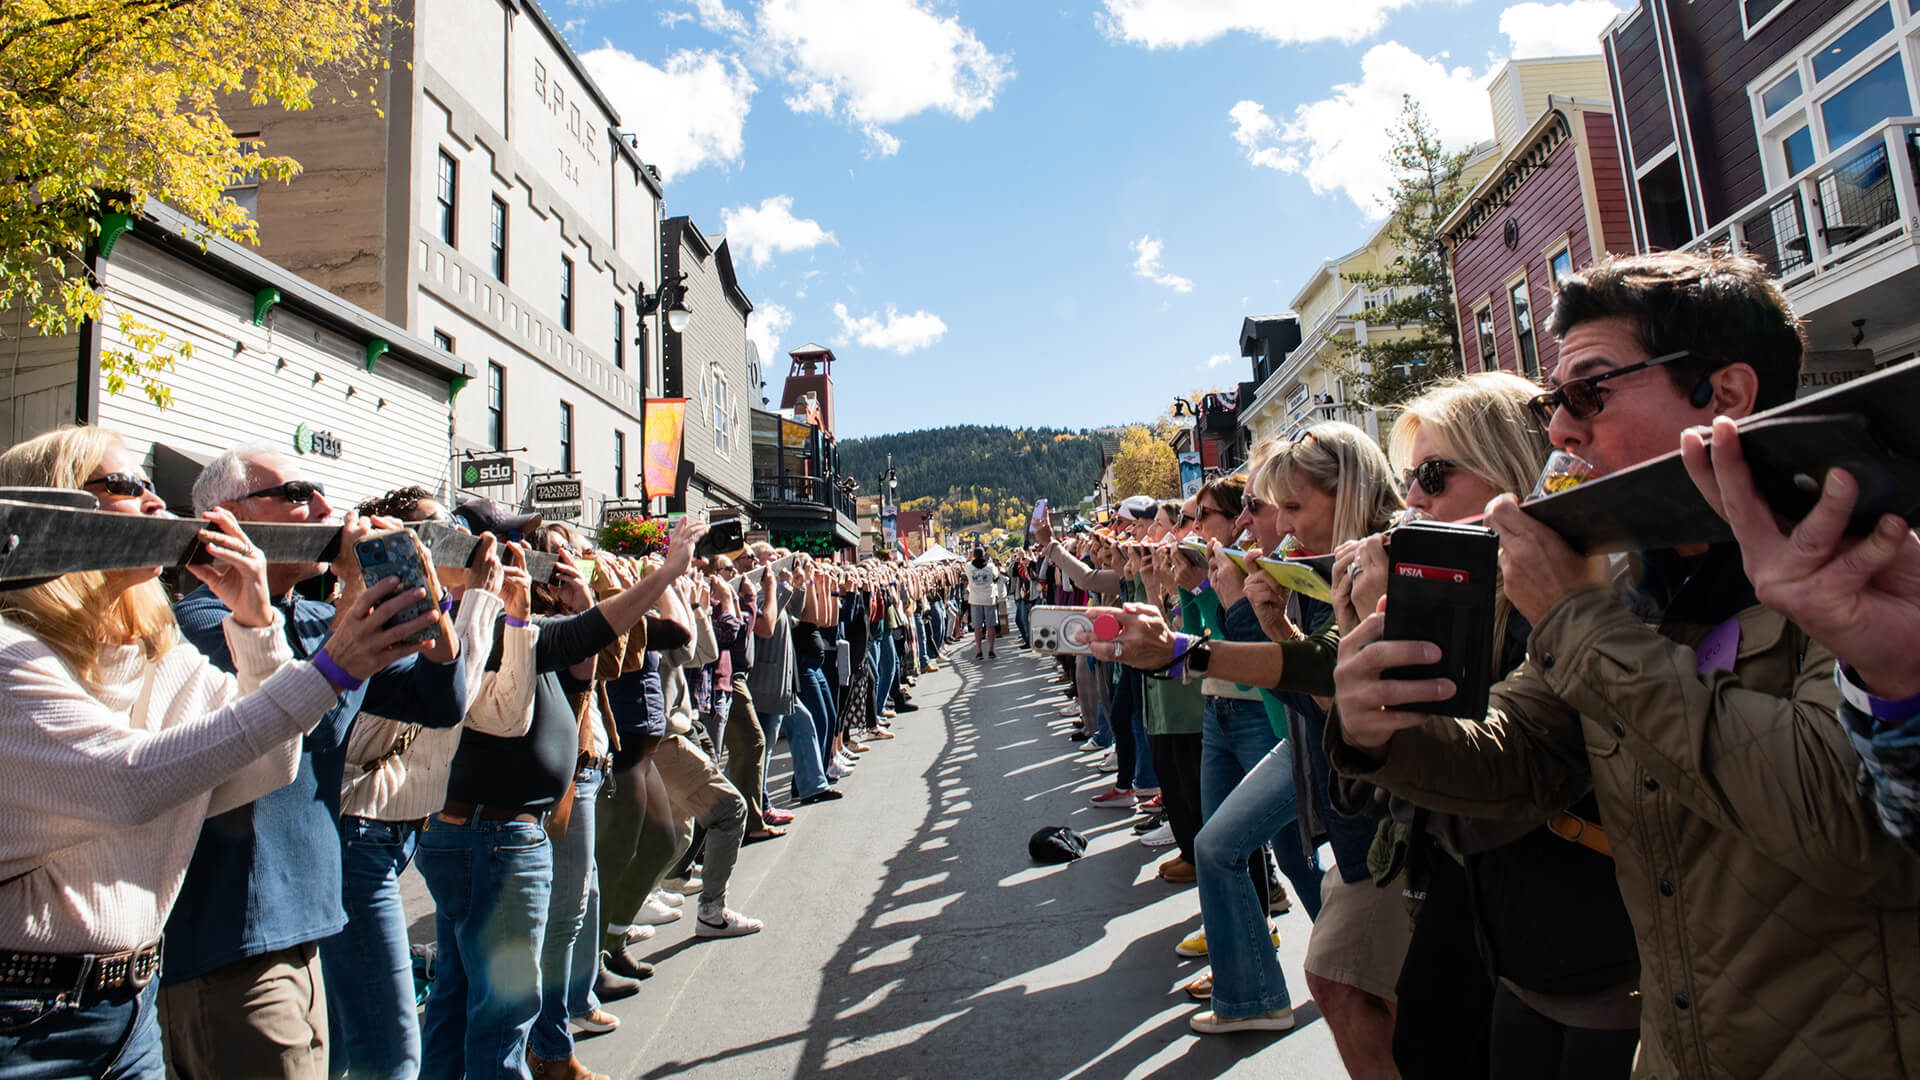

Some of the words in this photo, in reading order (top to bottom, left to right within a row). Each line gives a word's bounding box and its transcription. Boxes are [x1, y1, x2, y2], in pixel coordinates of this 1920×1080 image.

[558, 148, 579, 186] 134
[311, 430, 342, 459] stio
[480, 464, 511, 480] stio
[537, 484, 579, 495] TANNER
[538, 491, 579, 499] TRADING
[608, 511, 640, 520] TANNE
[1400, 566, 1424, 579] VISA
